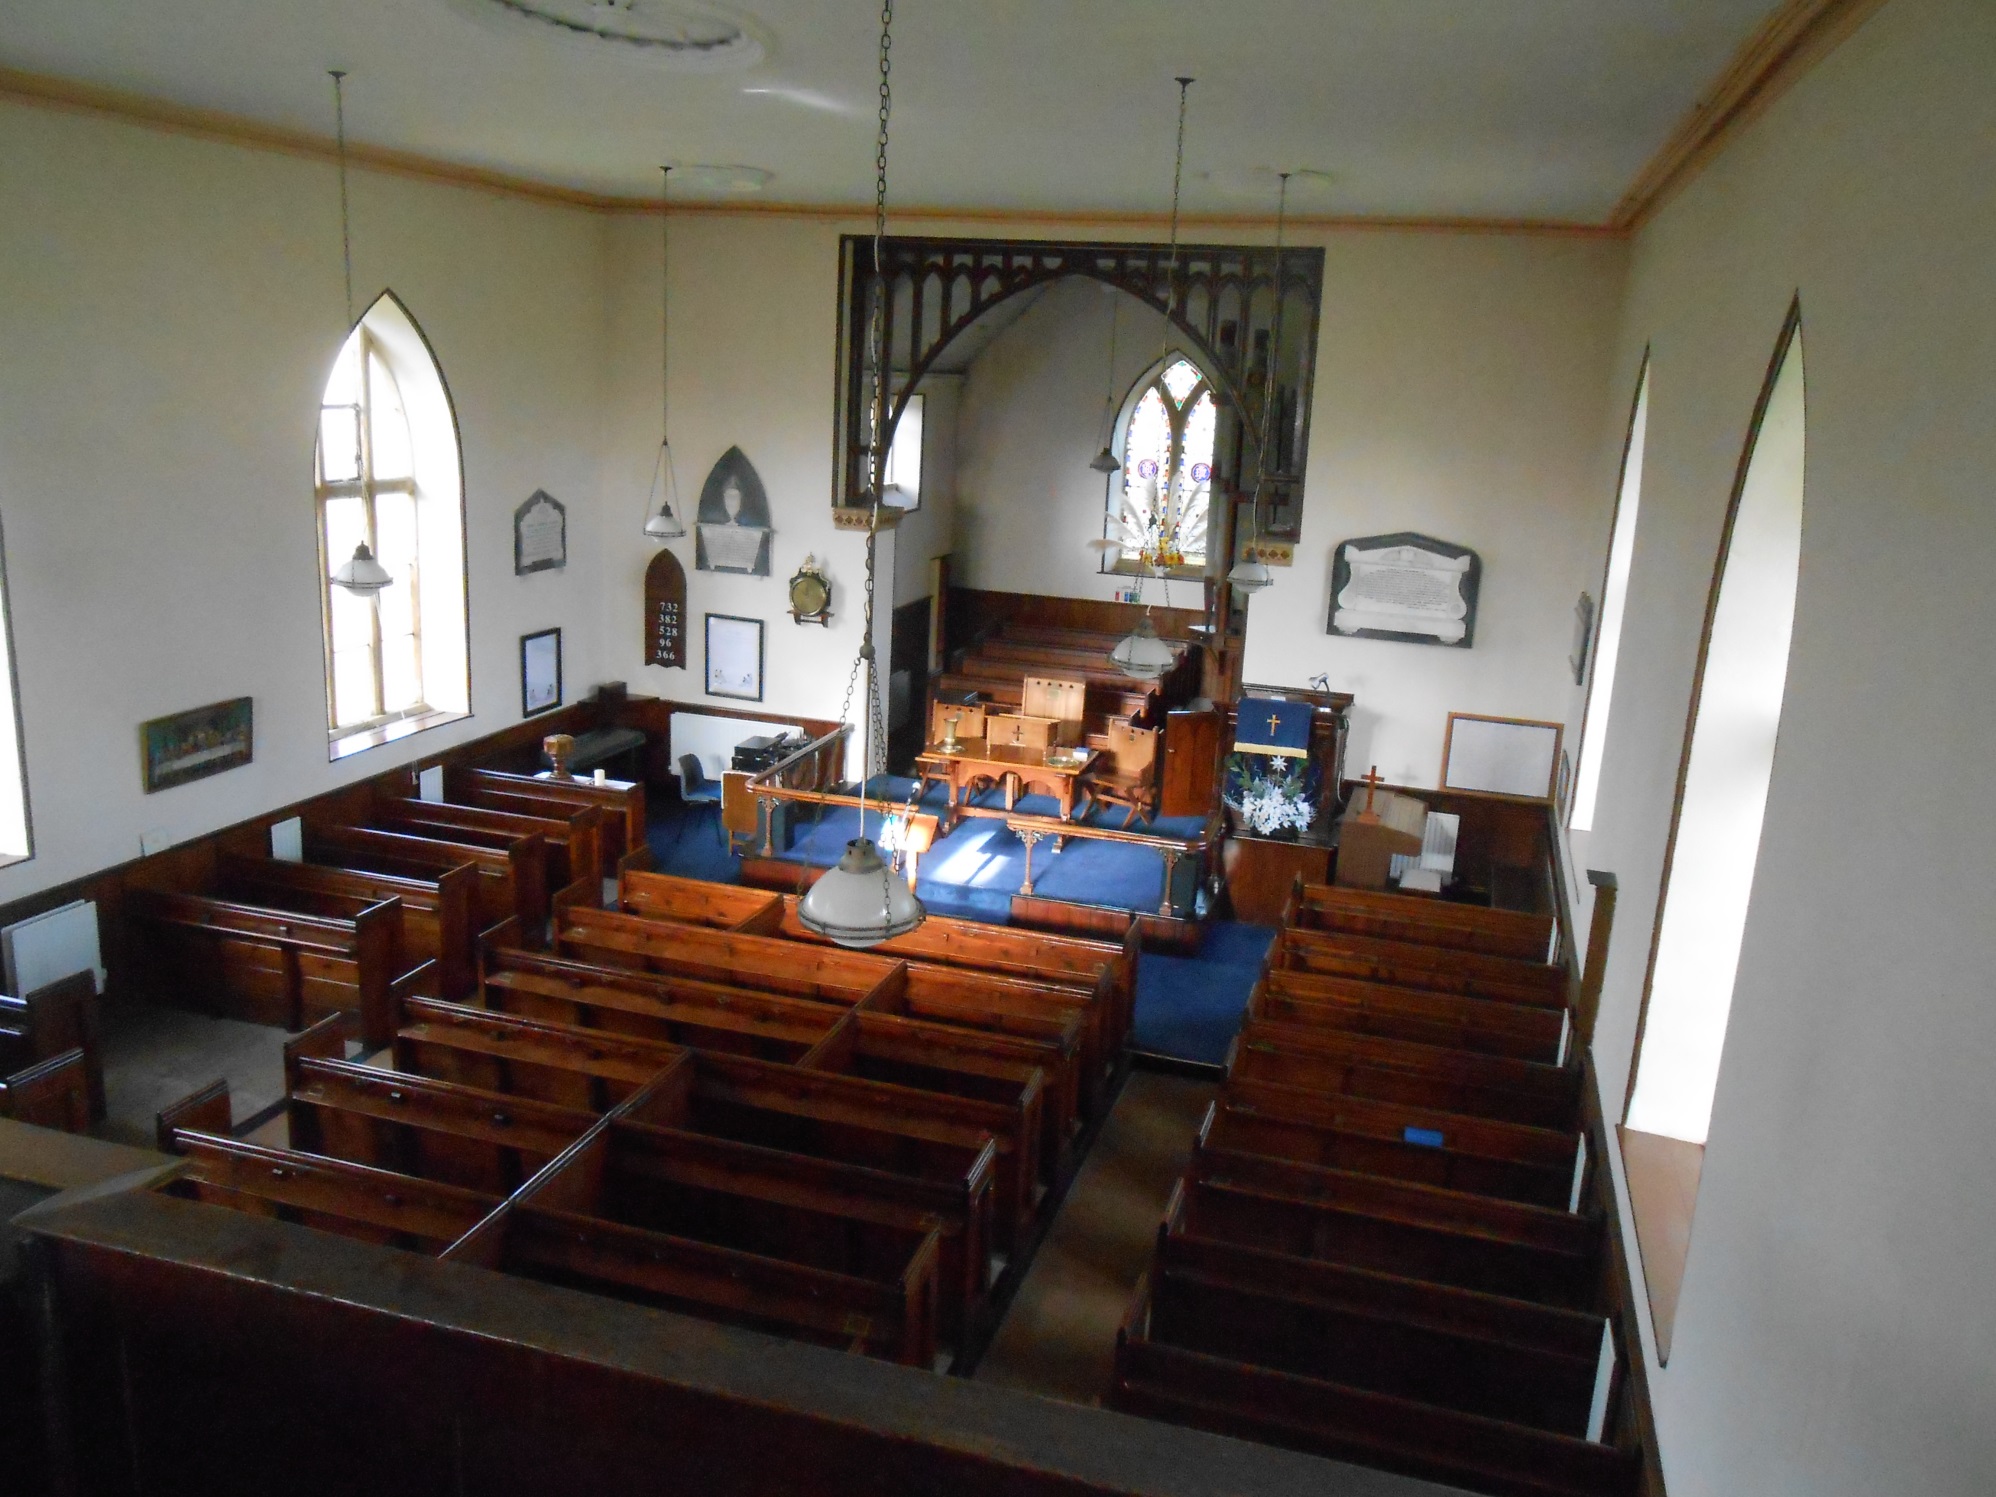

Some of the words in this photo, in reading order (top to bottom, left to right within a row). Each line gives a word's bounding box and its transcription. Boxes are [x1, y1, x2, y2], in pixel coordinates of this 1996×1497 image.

[659, 601, 678, 612] 732
[659, 614, 677, 624] 382
[659, 626, 678, 636] 528
[659, 638, 671, 647] 96
[656, 649, 675, 660] 366
